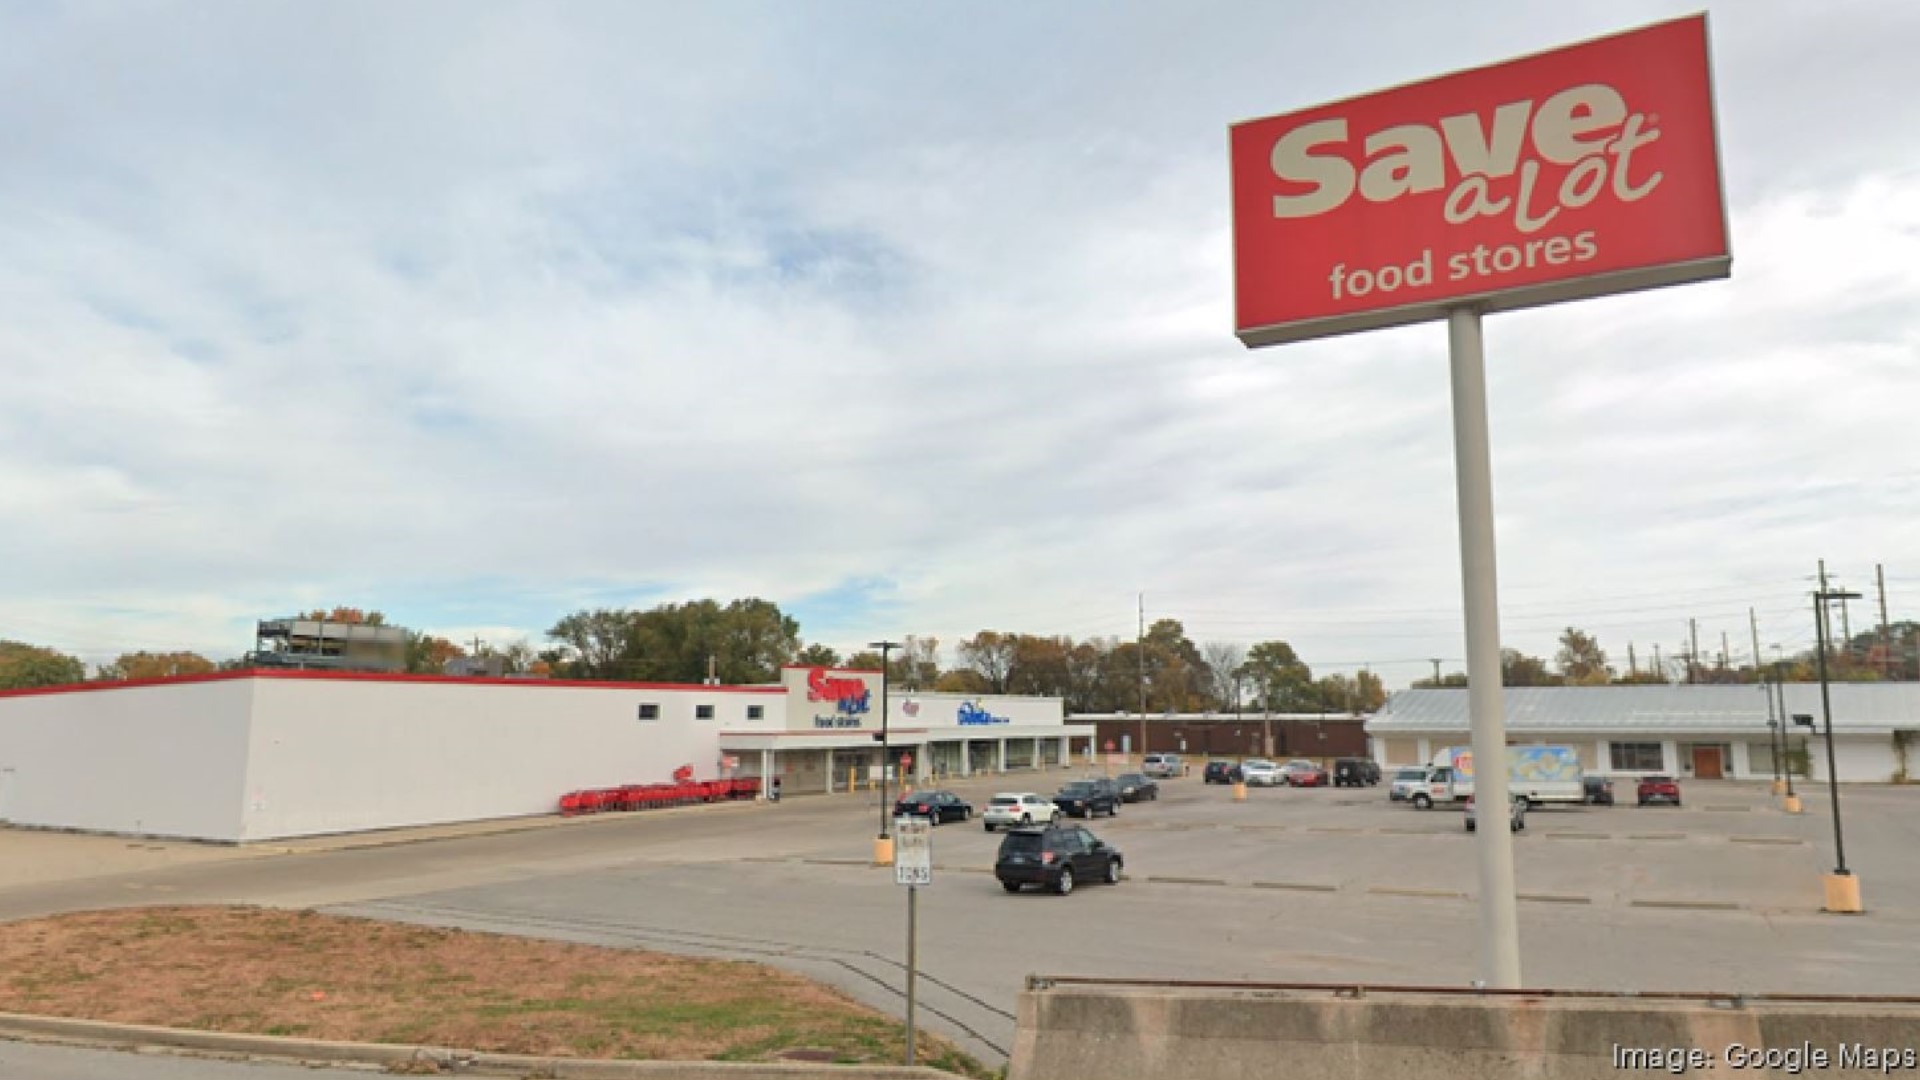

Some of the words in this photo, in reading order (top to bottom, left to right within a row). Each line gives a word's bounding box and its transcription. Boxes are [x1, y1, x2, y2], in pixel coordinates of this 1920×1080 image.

[1271, 83, 1627, 218] Save
[1329, 250, 1433, 300] food
[1449, 231, 1598, 281] stores
